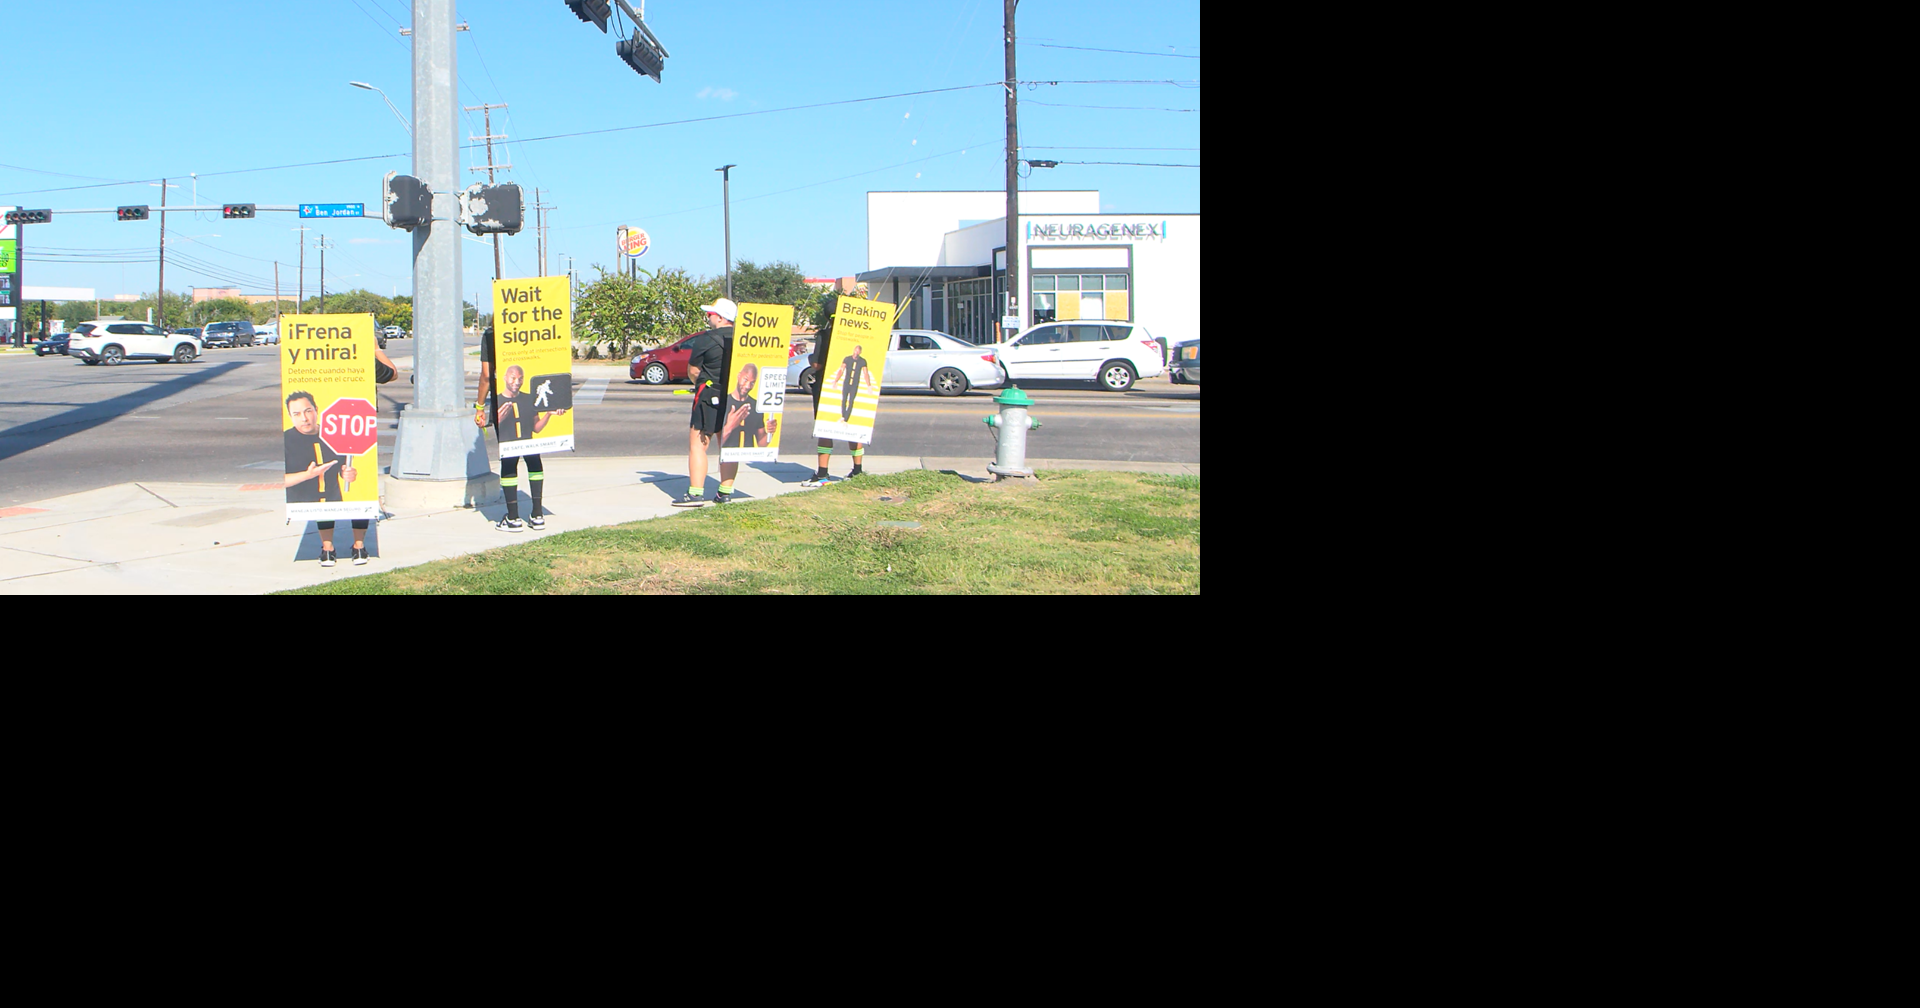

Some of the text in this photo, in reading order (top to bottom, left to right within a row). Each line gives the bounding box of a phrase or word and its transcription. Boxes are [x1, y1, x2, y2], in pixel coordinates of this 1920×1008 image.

[1034, 223, 1158, 236] NEURAGENEX
[621, 233, 645, 246] BRGER
[501, 286, 542, 304] Wait
[501, 306, 562, 324] for the
[742, 311, 779, 328] Slow
[842, 302, 887, 322] Braking
[288, 323, 352, 340] ¡Frena
[840, 318, 872, 330] news.
[503, 325, 561, 346] signal.
[739, 332, 784, 348] down.
[288, 344, 357, 364] y mira!
[347, 367, 365, 375] haya
[288, 376, 321, 384] peatones
[763, 392, 784, 406] 25
[324, 414, 377, 436] STOP
